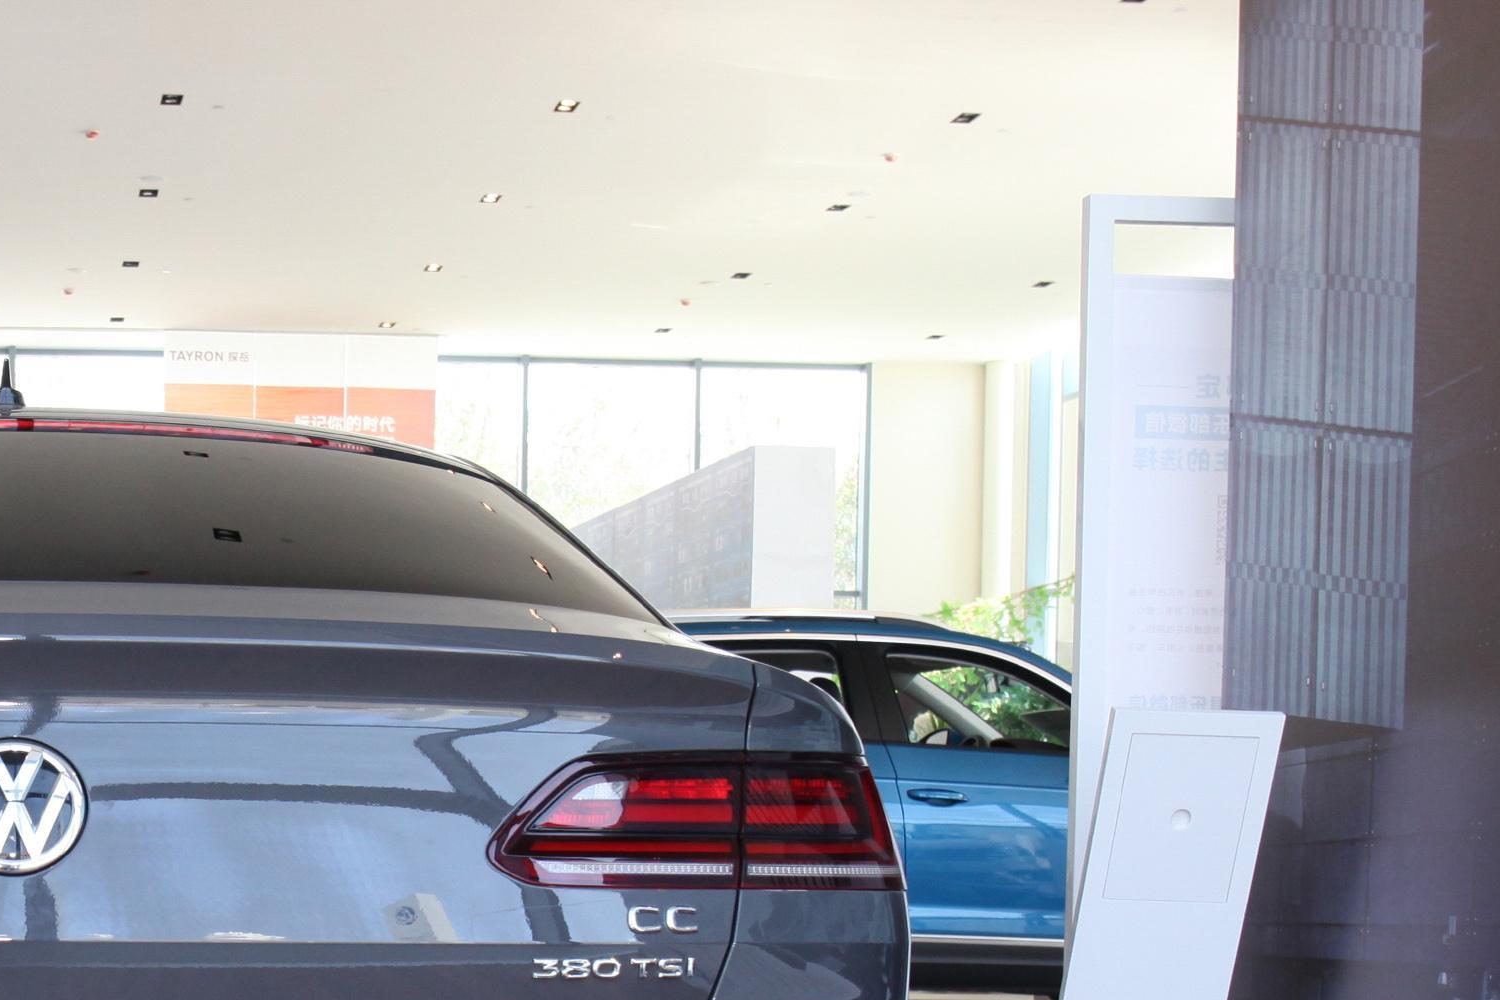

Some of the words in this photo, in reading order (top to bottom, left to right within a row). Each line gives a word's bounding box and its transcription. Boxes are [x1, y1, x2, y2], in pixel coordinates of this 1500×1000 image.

[170, 350, 224, 362] TAYRON
[627, 905, 699, 933] CC
[532, 957, 622, 979] 380
[630, 956, 696, 979] TSI
